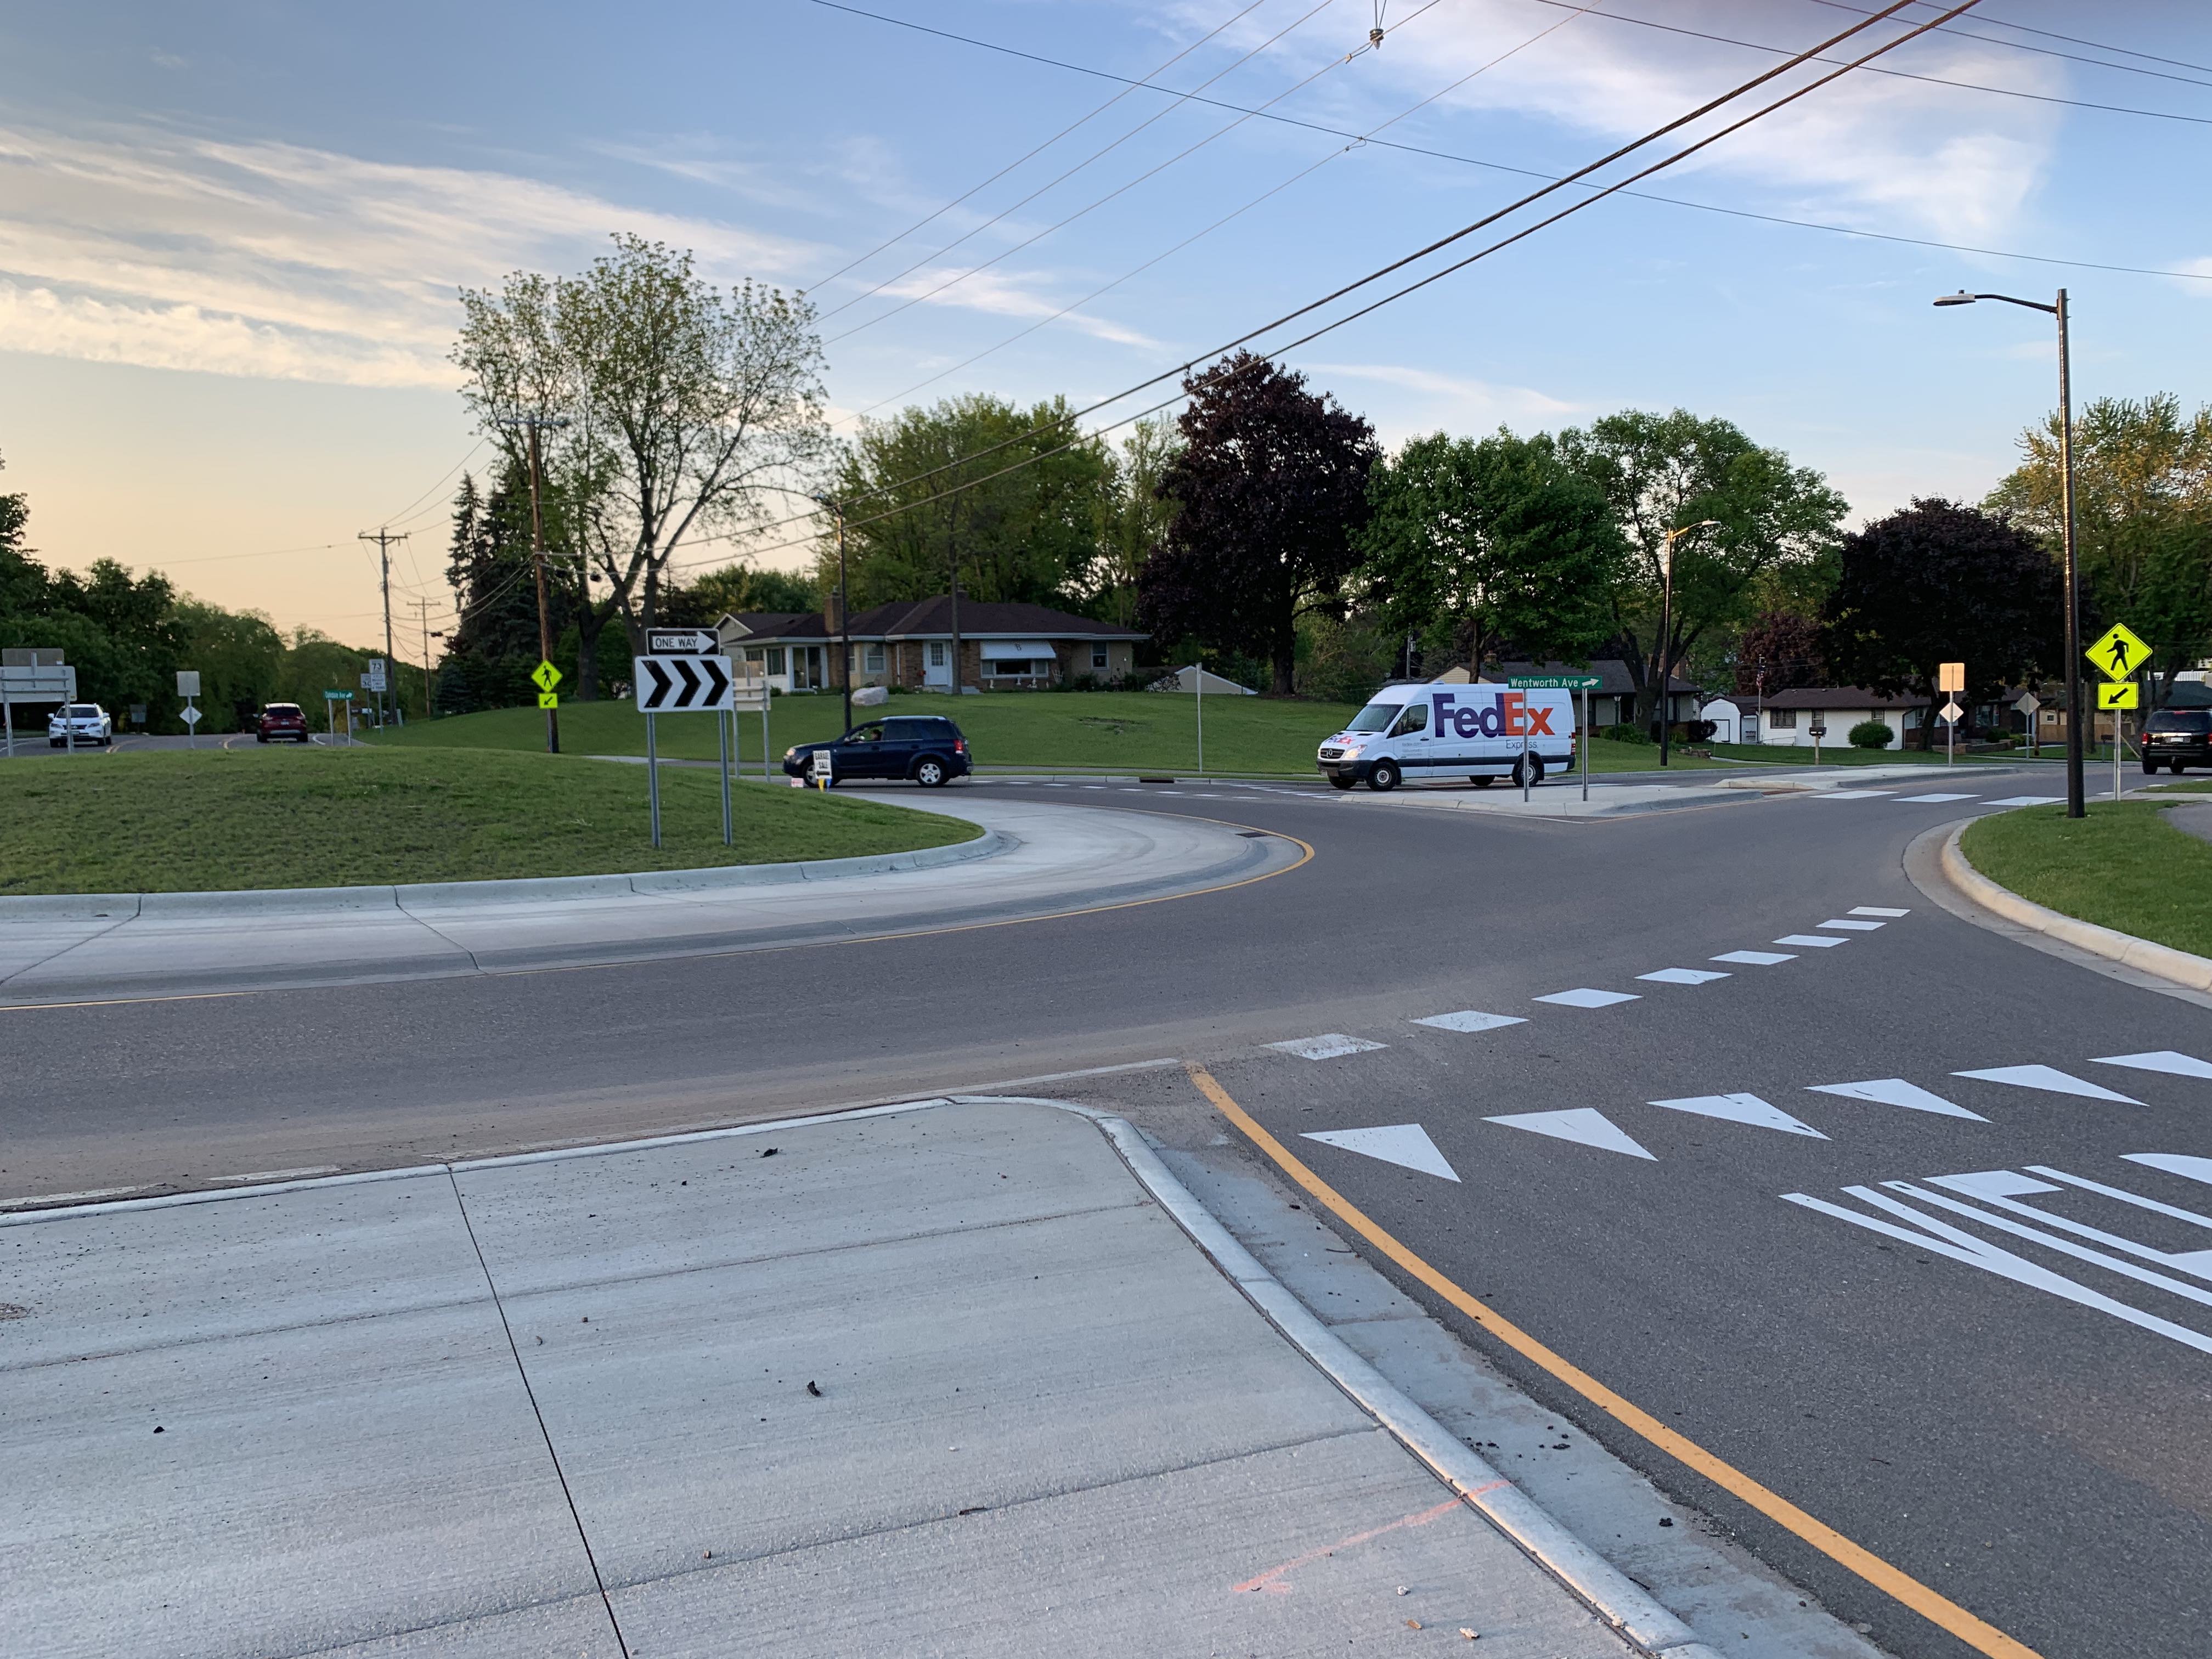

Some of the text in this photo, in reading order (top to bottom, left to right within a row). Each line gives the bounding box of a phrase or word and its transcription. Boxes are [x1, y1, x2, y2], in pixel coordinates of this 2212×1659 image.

[656, 637, 697, 647] ONE WAY
[1510, 678, 1578, 687] Wentworth Ave
[1432, 692, 1555, 738] FedEx
[1505, 739, 1537, 751] Exprss
[815, 752, 830, 760] GARAGE
